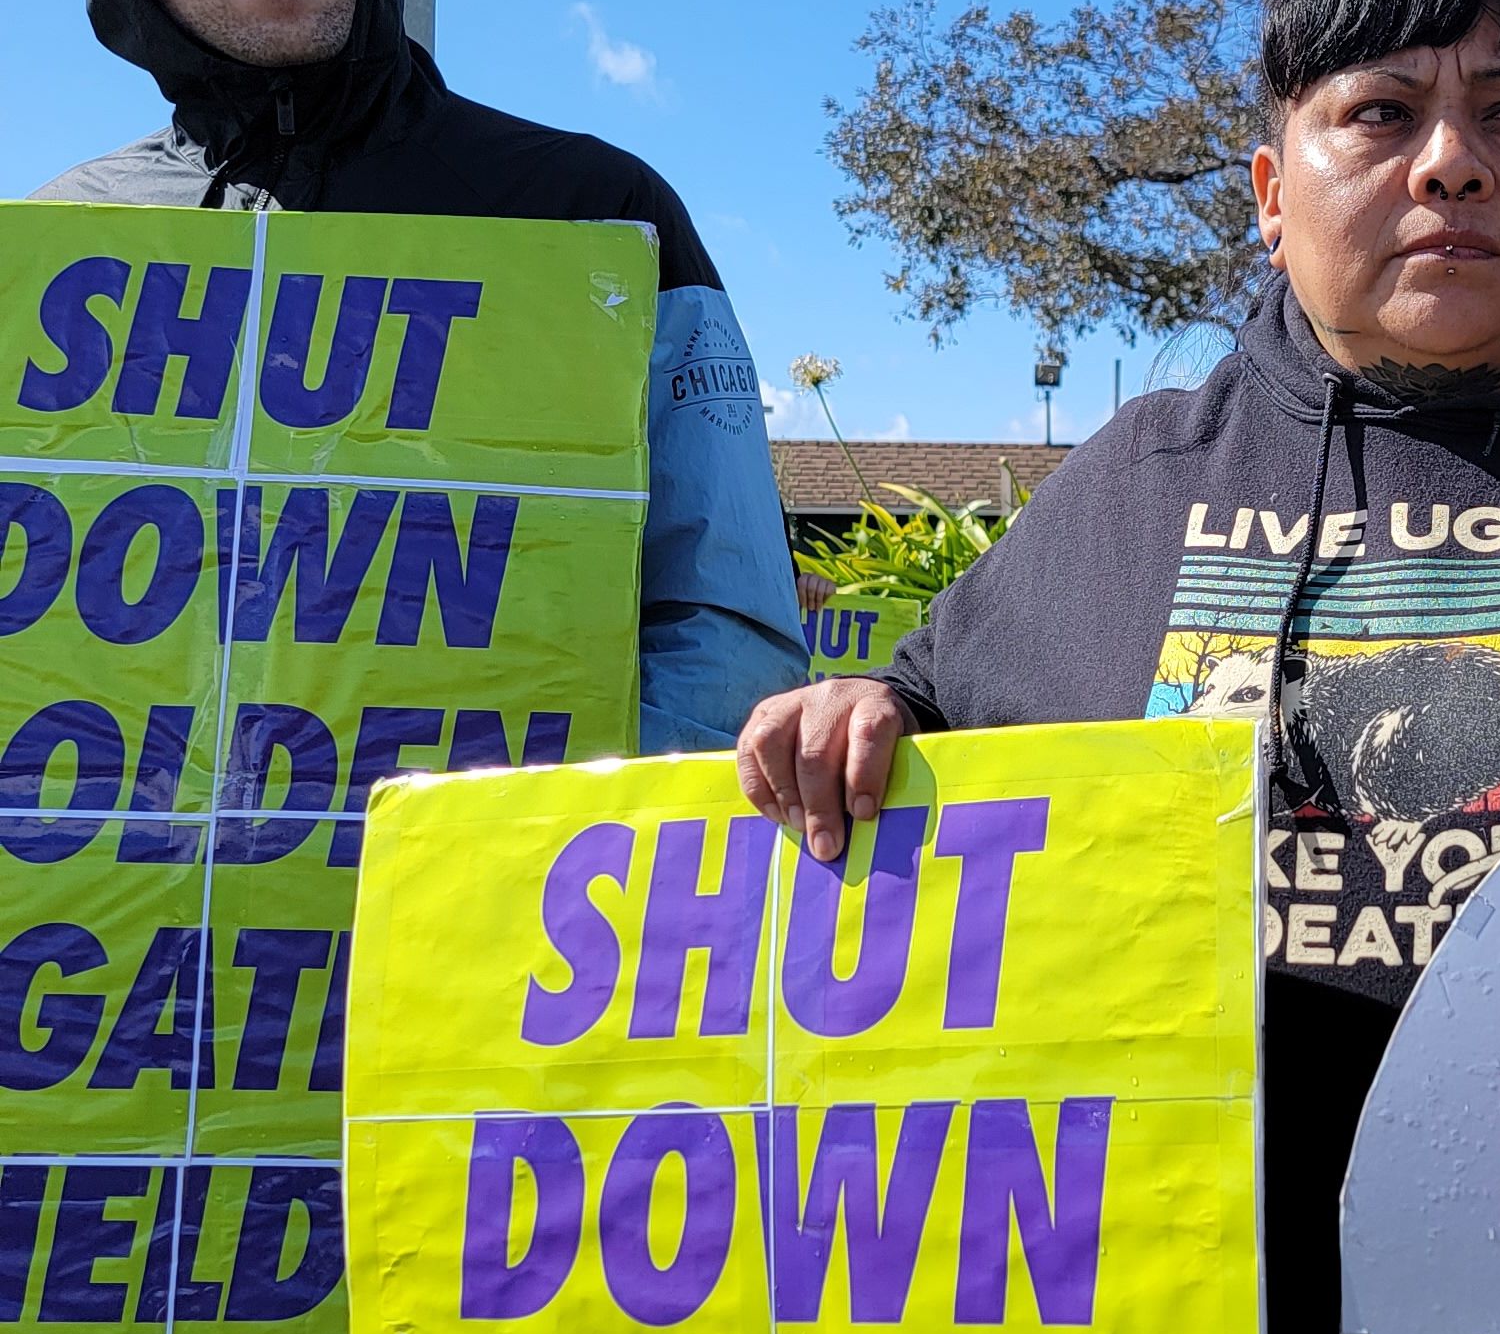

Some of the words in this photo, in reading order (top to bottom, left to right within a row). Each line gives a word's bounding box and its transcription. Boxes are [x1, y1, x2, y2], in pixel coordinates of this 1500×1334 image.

[17, 256, 483, 431] SHUT
[671, 364, 756, 401] CHICAGO
[684, 328, 703, 357] BANK
[0, 481, 520, 648] DOWN
[1184, 503, 1368, 559] LIVE
[521, 798, 1052, 1047] SHUT
[460, 1096, 1116, 1328] DOWN
